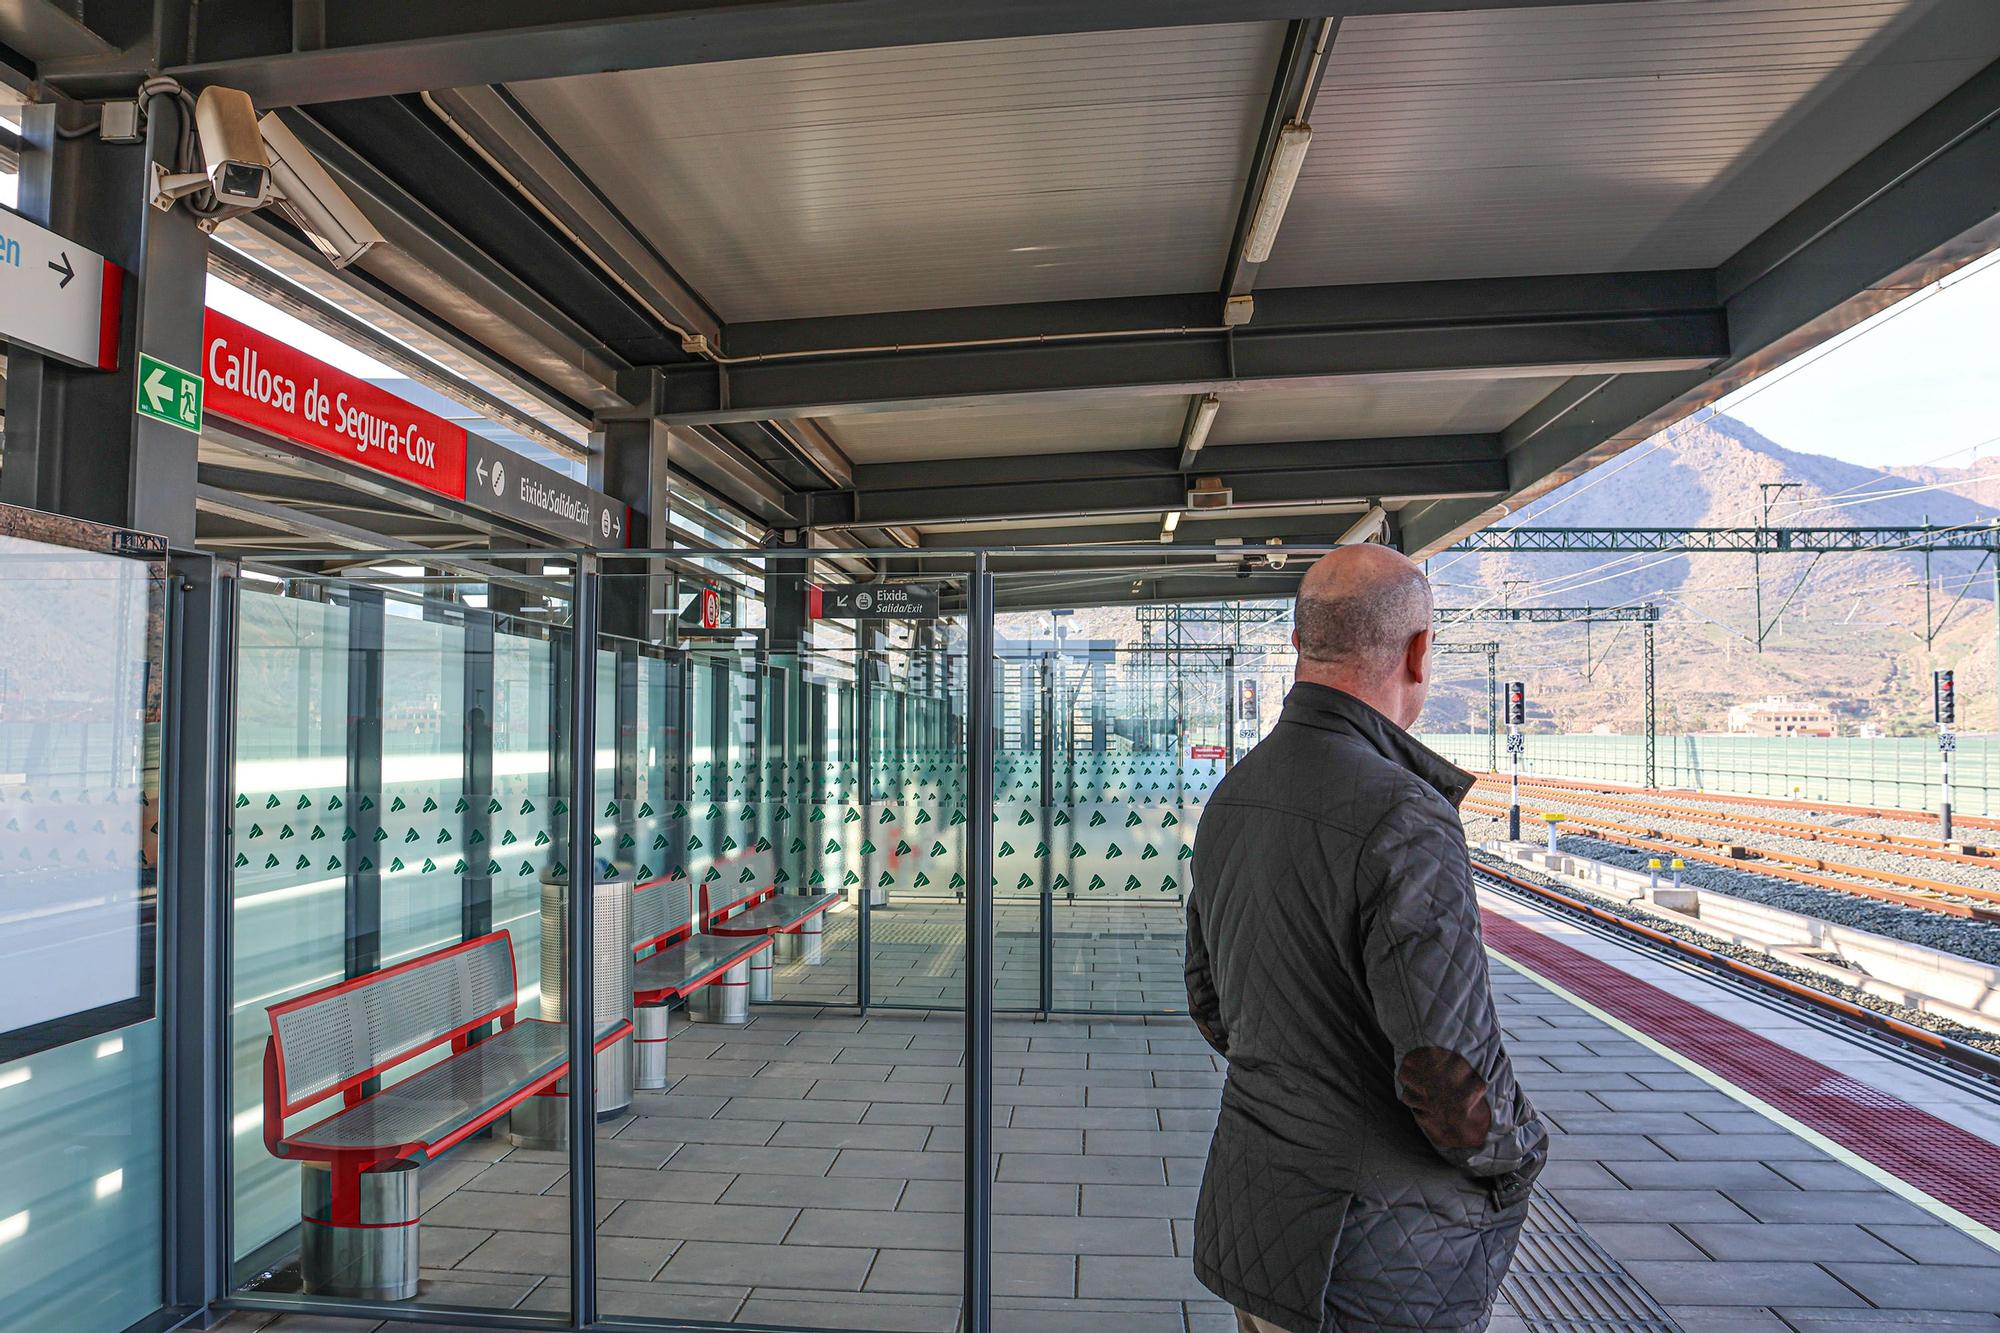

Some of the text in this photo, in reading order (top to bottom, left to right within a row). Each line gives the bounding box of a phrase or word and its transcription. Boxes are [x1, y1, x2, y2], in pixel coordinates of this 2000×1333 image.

[209, 337, 436, 469] Callosa de Segura-Cox
[520, 477, 590, 526] Eixida/Salida/Exit
[875, 603, 923, 613] Salida/Exit
[876, 589, 908, 601] Eixida
